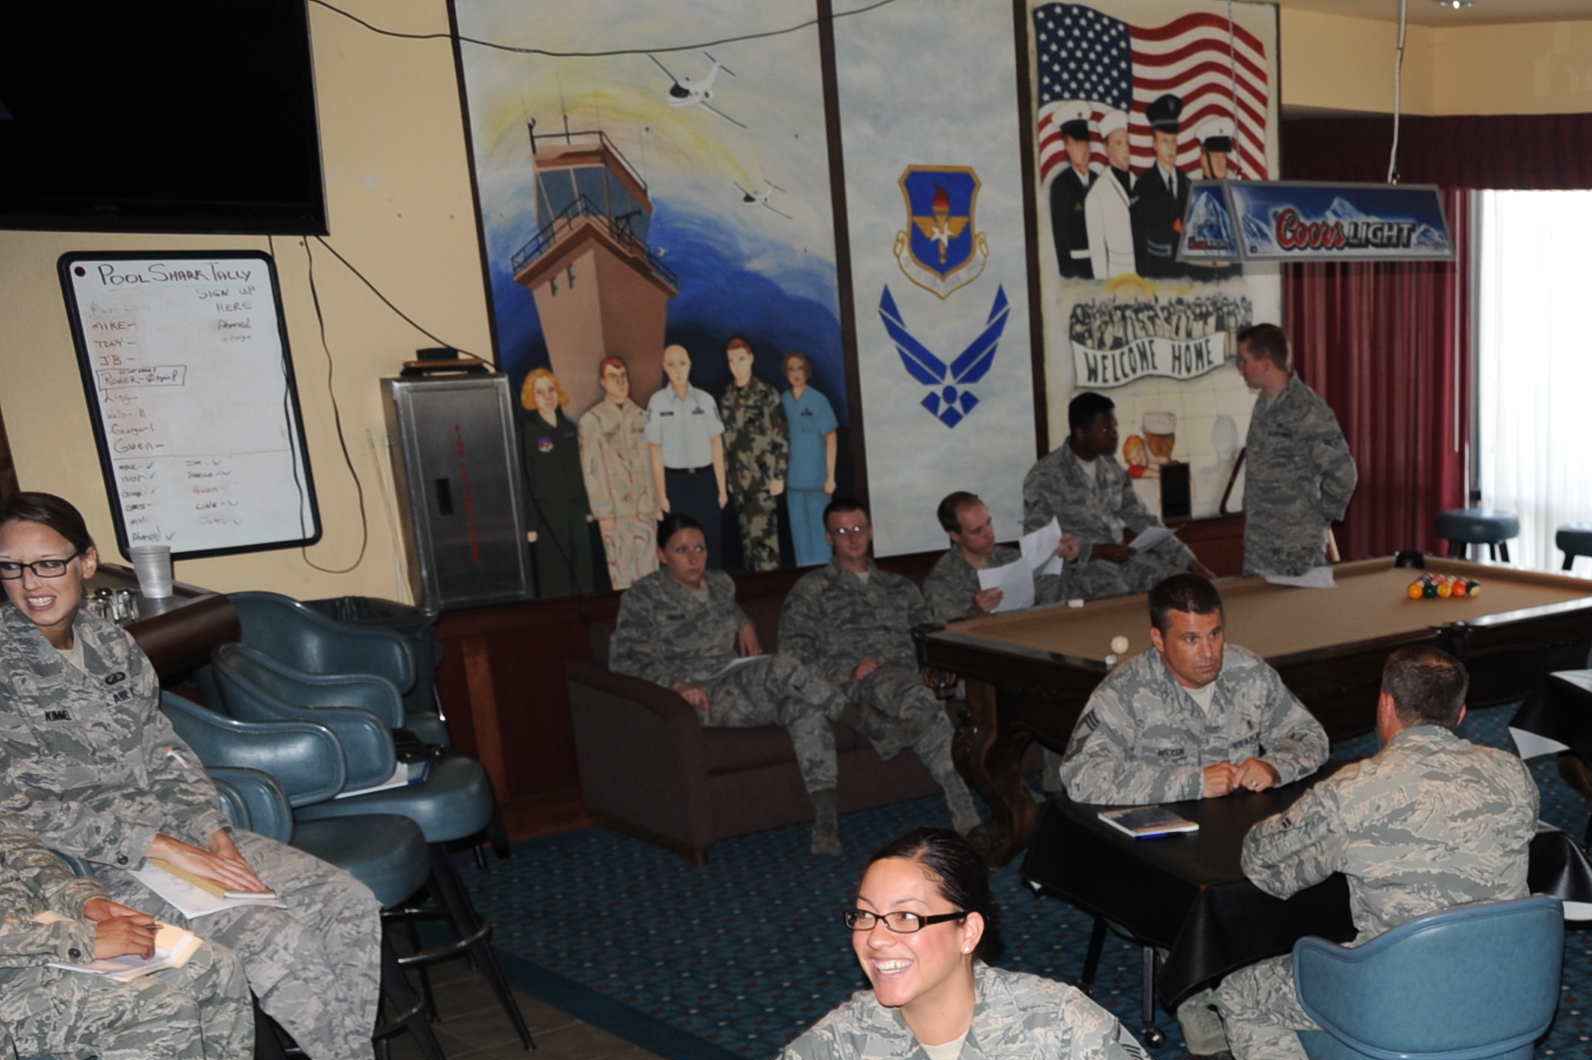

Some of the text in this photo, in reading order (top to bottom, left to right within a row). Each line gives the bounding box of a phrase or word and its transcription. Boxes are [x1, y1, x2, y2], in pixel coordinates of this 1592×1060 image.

[1273, 206, 1417, 251] Coors LIGHT
[97, 262, 252, 286] POOL SHARK TALLY
[196, 287, 230, 300] SIGN
[216, 301, 253, 313] HERE
[1084, 338, 1214, 383] WELCOME HOME
